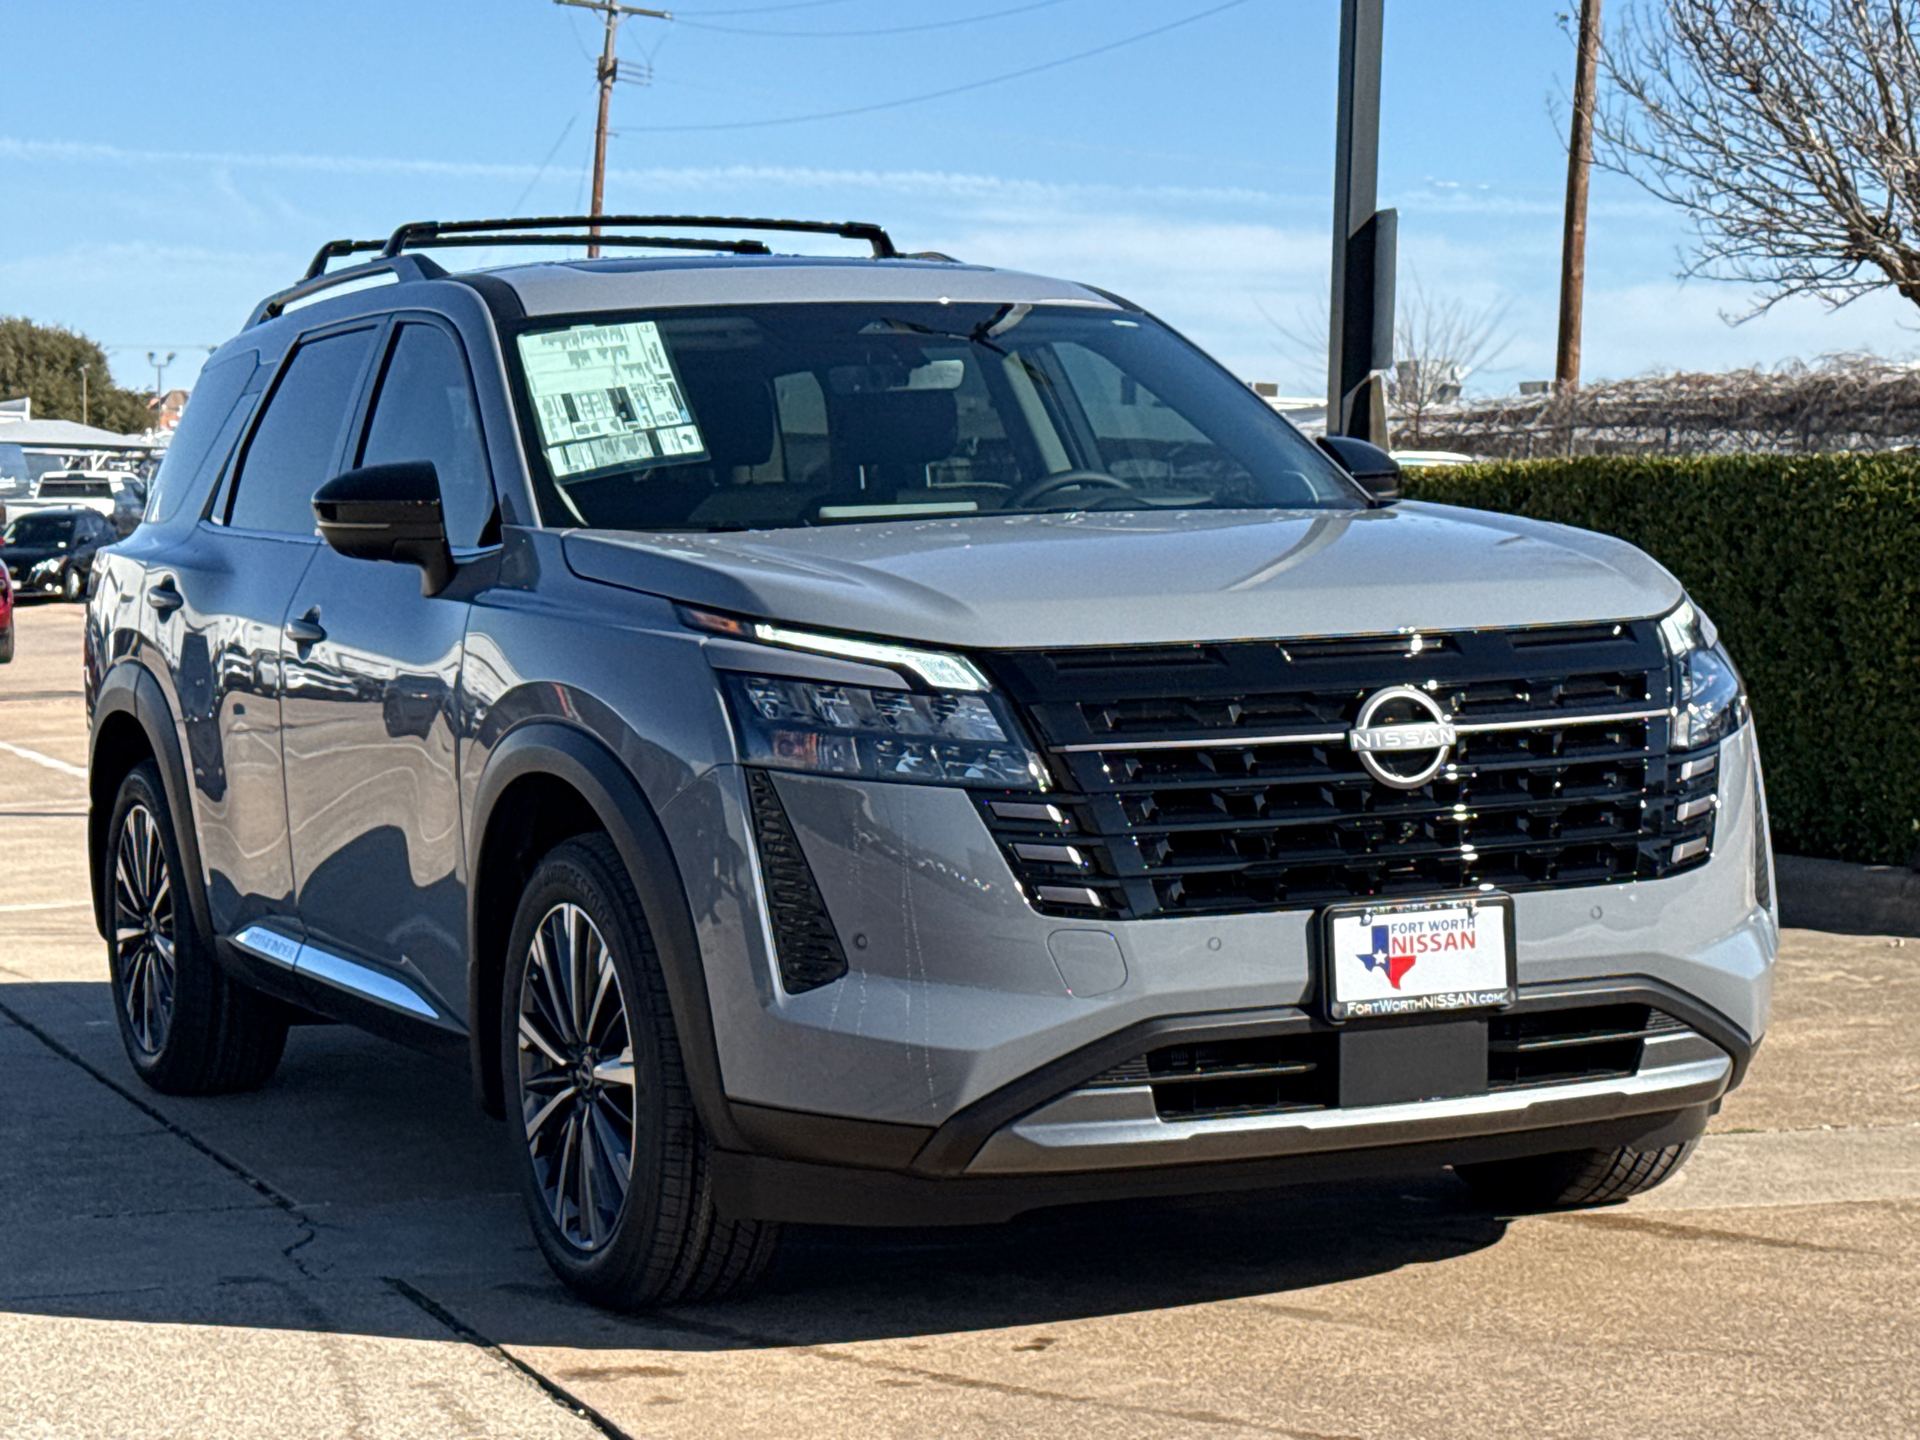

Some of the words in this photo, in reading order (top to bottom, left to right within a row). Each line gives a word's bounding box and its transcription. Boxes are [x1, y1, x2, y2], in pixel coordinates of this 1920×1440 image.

[1353, 727, 1454, 748] NISSAN
[1391, 921, 1424, 934] FORT
[1429, 917, 1475, 931] WORTH
[1392, 931, 1476, 954] NISSAN
